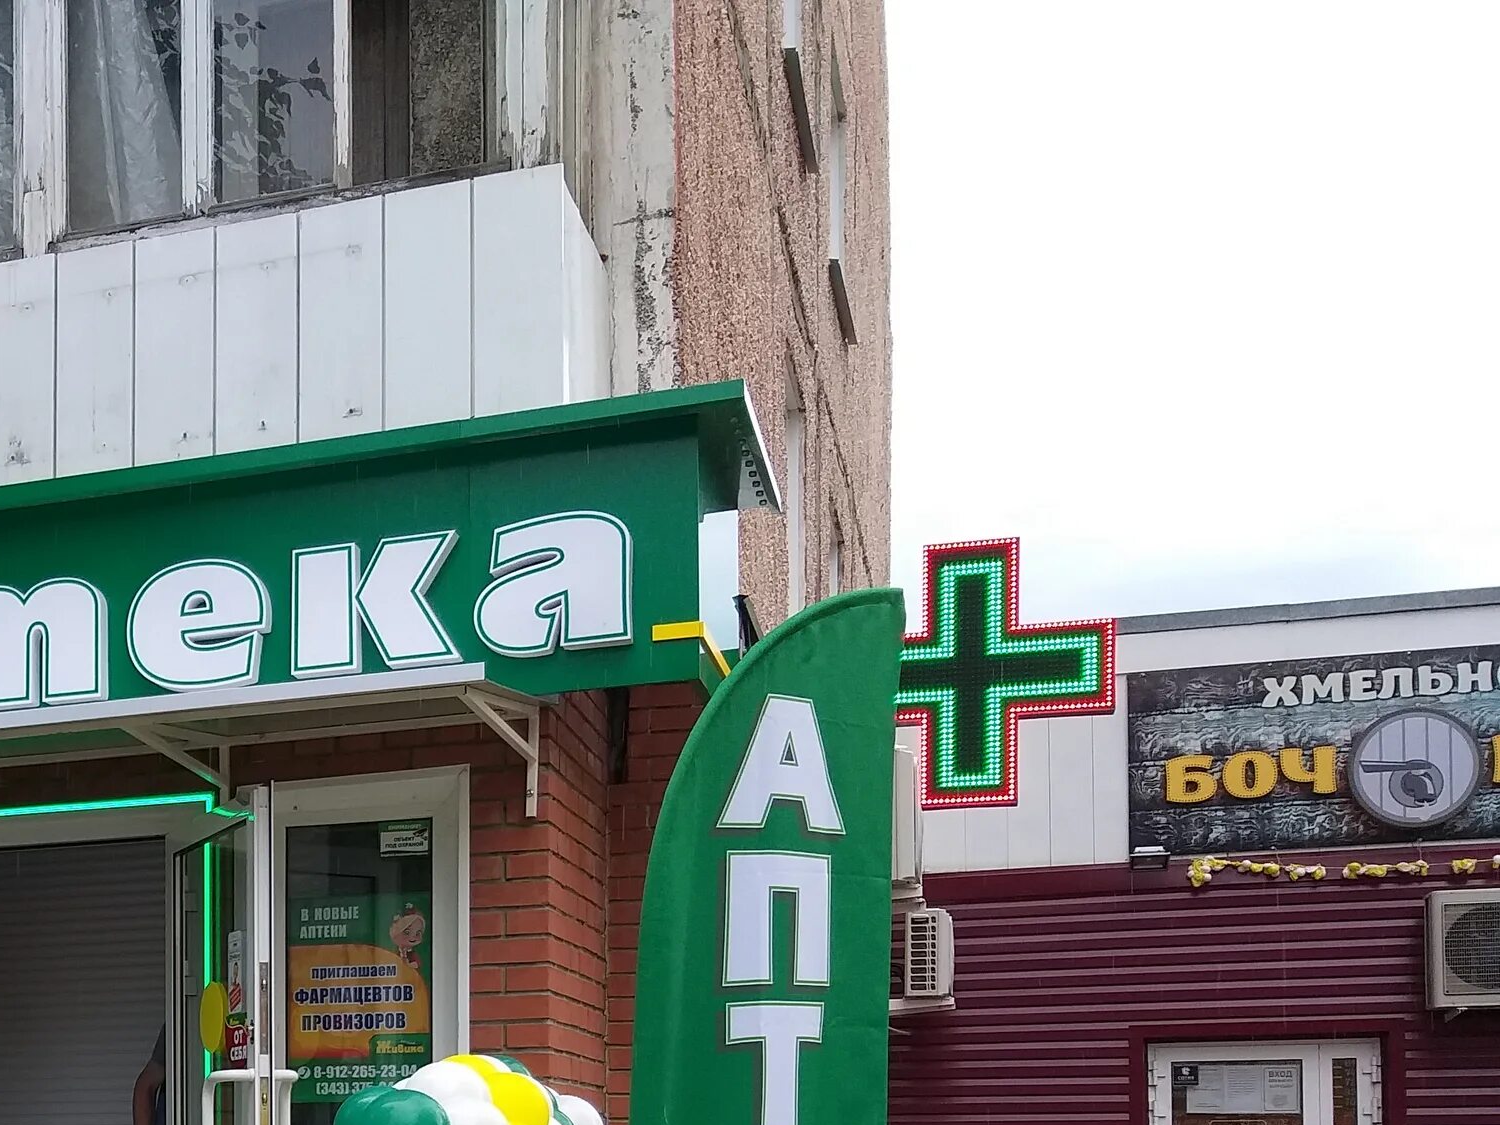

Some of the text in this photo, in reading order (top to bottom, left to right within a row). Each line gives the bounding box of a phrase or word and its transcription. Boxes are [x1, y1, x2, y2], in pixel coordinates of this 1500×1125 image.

[1261, 660, 1500, 708] ХМЕЛЬН
[301, 906, 360, 922] В НОВЫЕ
[300, 924, 347, 939] АПТЕКИ
[311, 965, 397, 980] приглашаем
[294, 985, 414, 1005] ФАРМАЦЕВТОВ
[301, 1012, 407, 1031] ПРОВИЗОРОВ
[233, 1029, 244, 1044] ОТ
[316, 1081, 350, 1095] (343)
